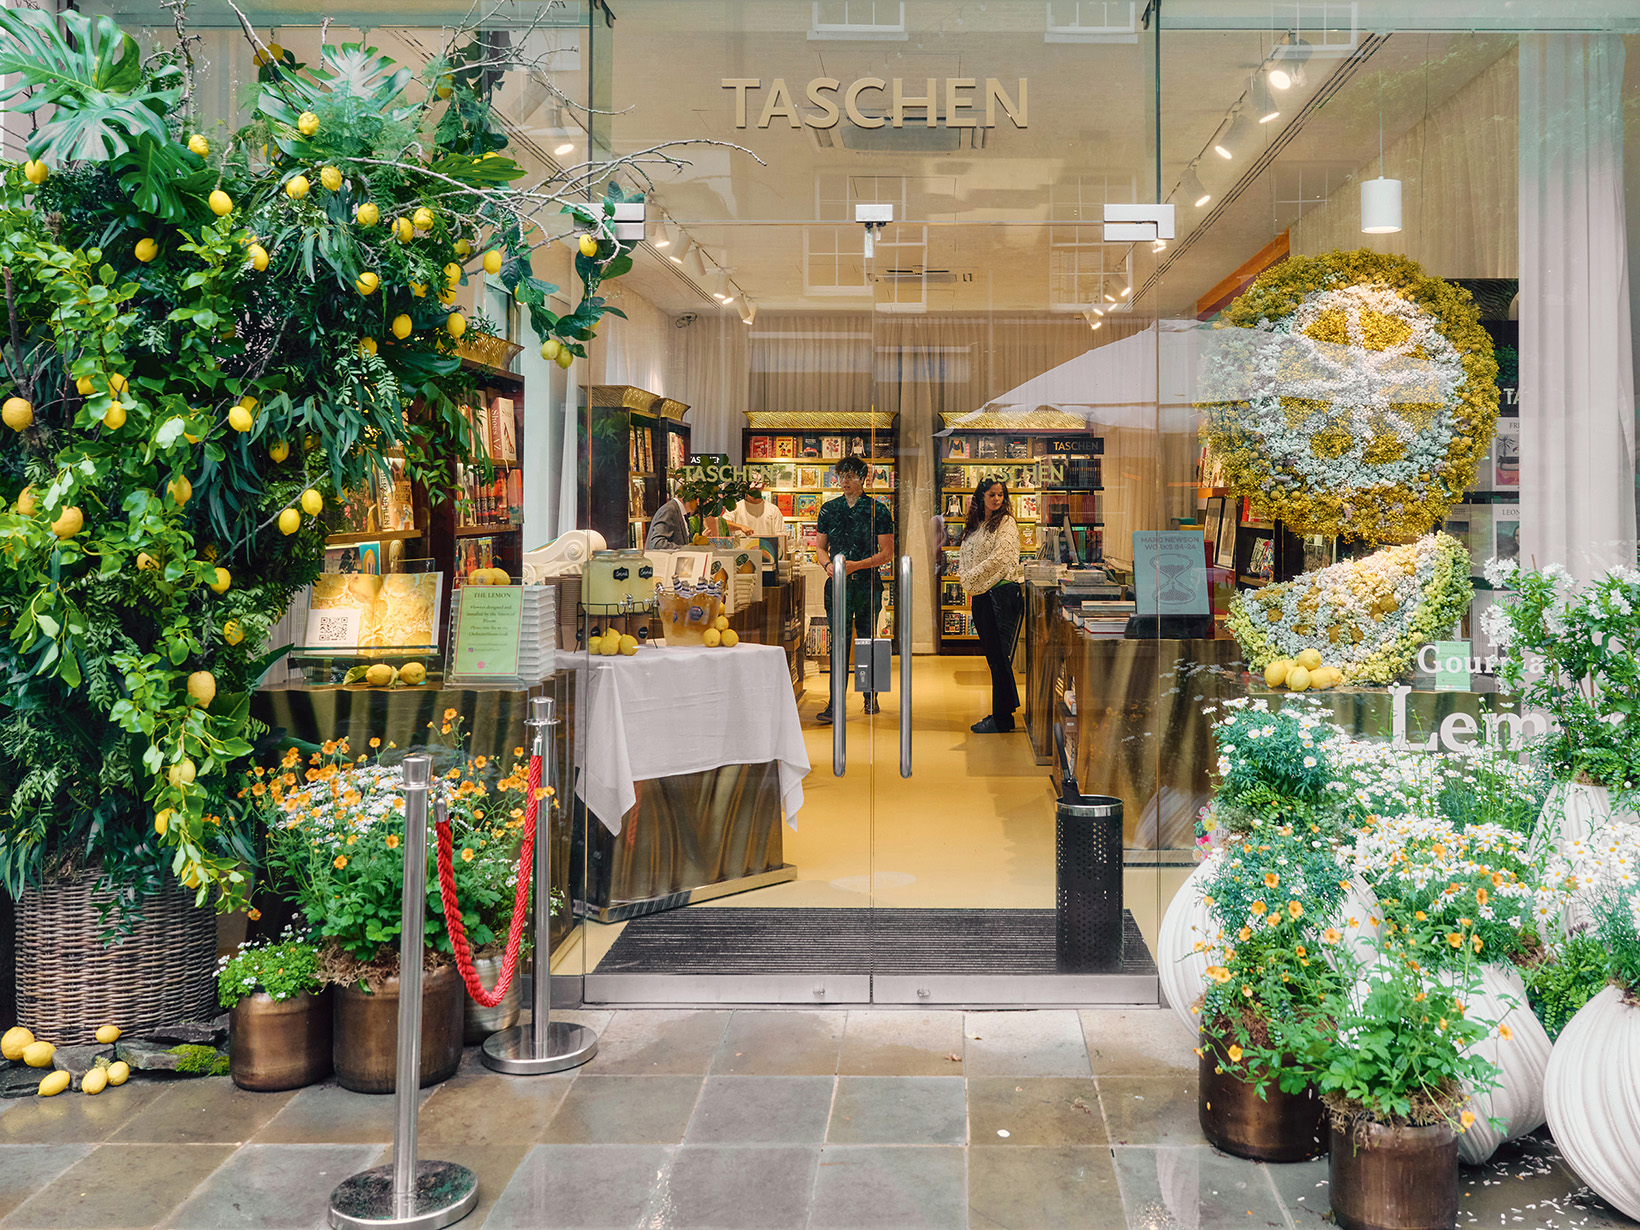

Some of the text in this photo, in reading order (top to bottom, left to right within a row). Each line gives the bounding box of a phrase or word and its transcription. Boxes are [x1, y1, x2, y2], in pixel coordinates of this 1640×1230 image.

[721, 77, 1029, 129] TASCHEN
[491, 409, 501, 436] Shoes
[1053, 441, 1098, 451] TASCHEN
[681, 465, 775, 483] TASCHEN
[973, 465, 1064, 483] TASCHEN
